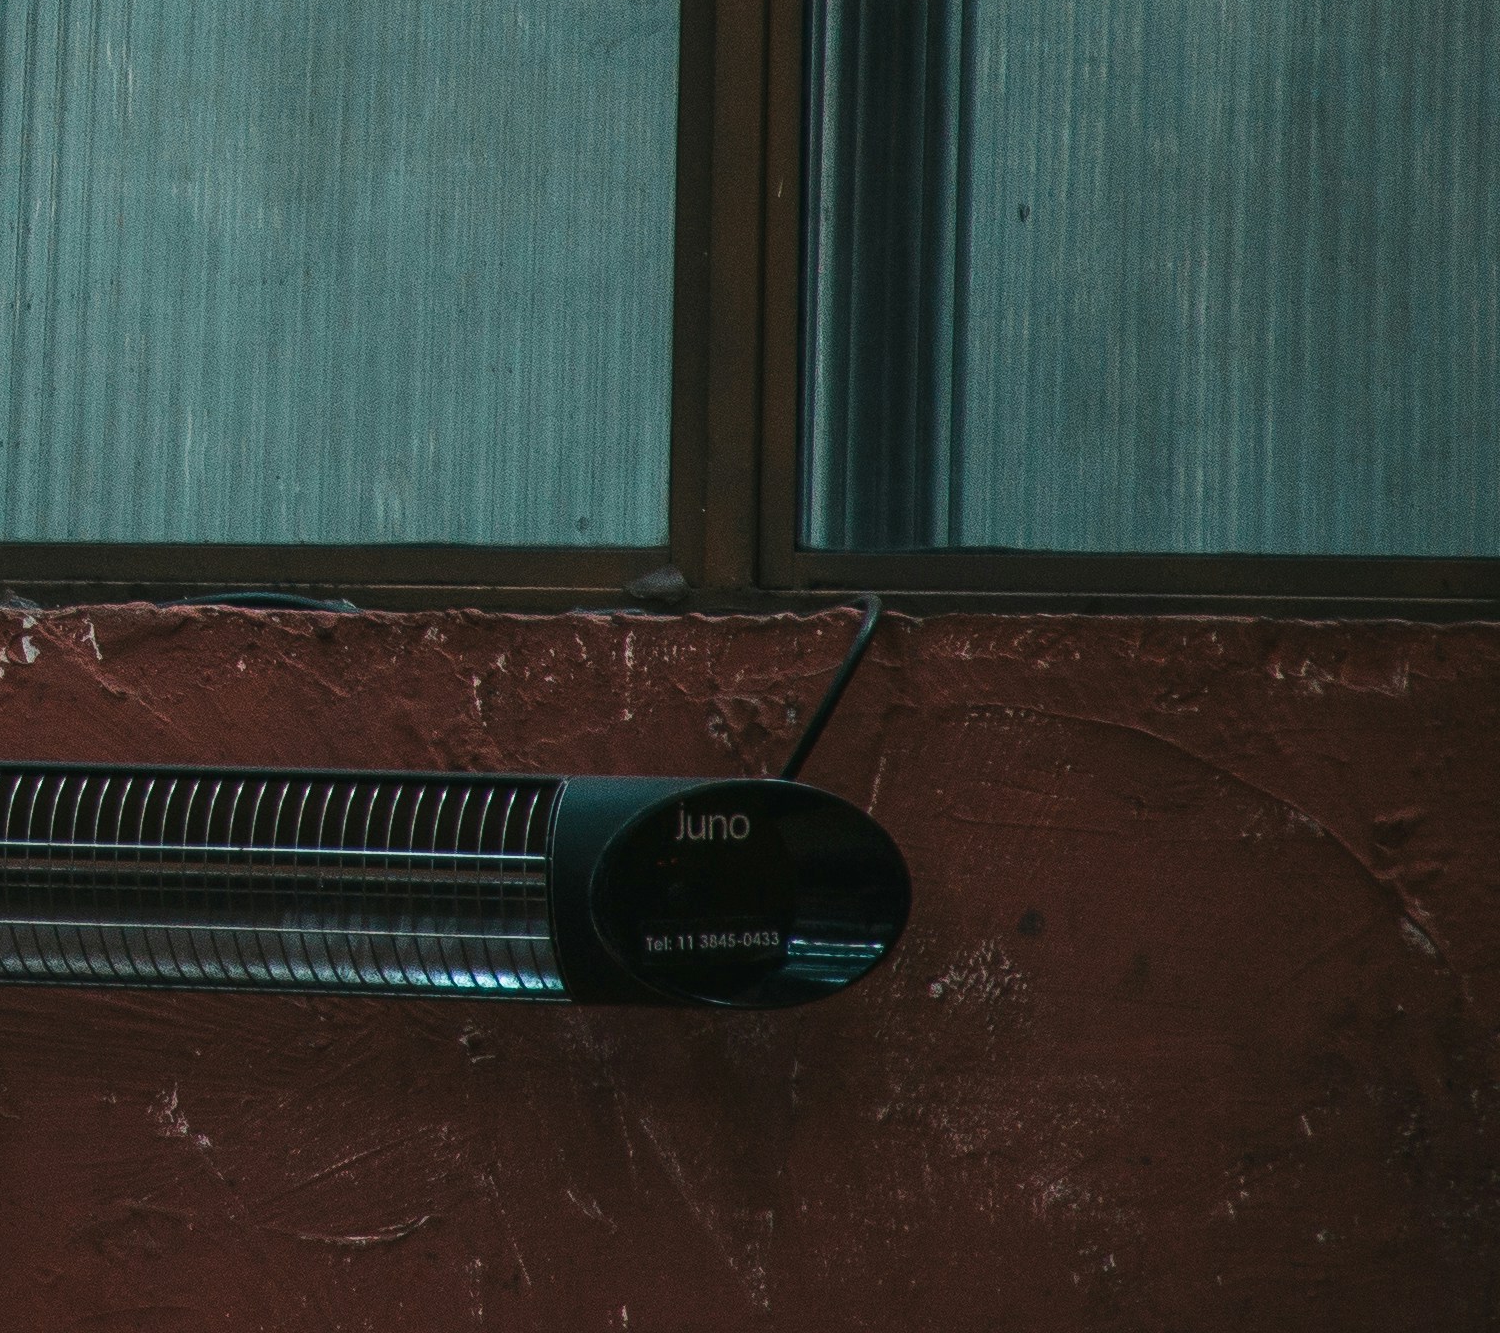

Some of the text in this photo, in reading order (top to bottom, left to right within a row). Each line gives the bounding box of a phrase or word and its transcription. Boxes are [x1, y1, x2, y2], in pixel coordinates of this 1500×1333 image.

[674, 801, 752, 841] juno
[645, 930, 780, 953] Tel: 11 3845-0433
